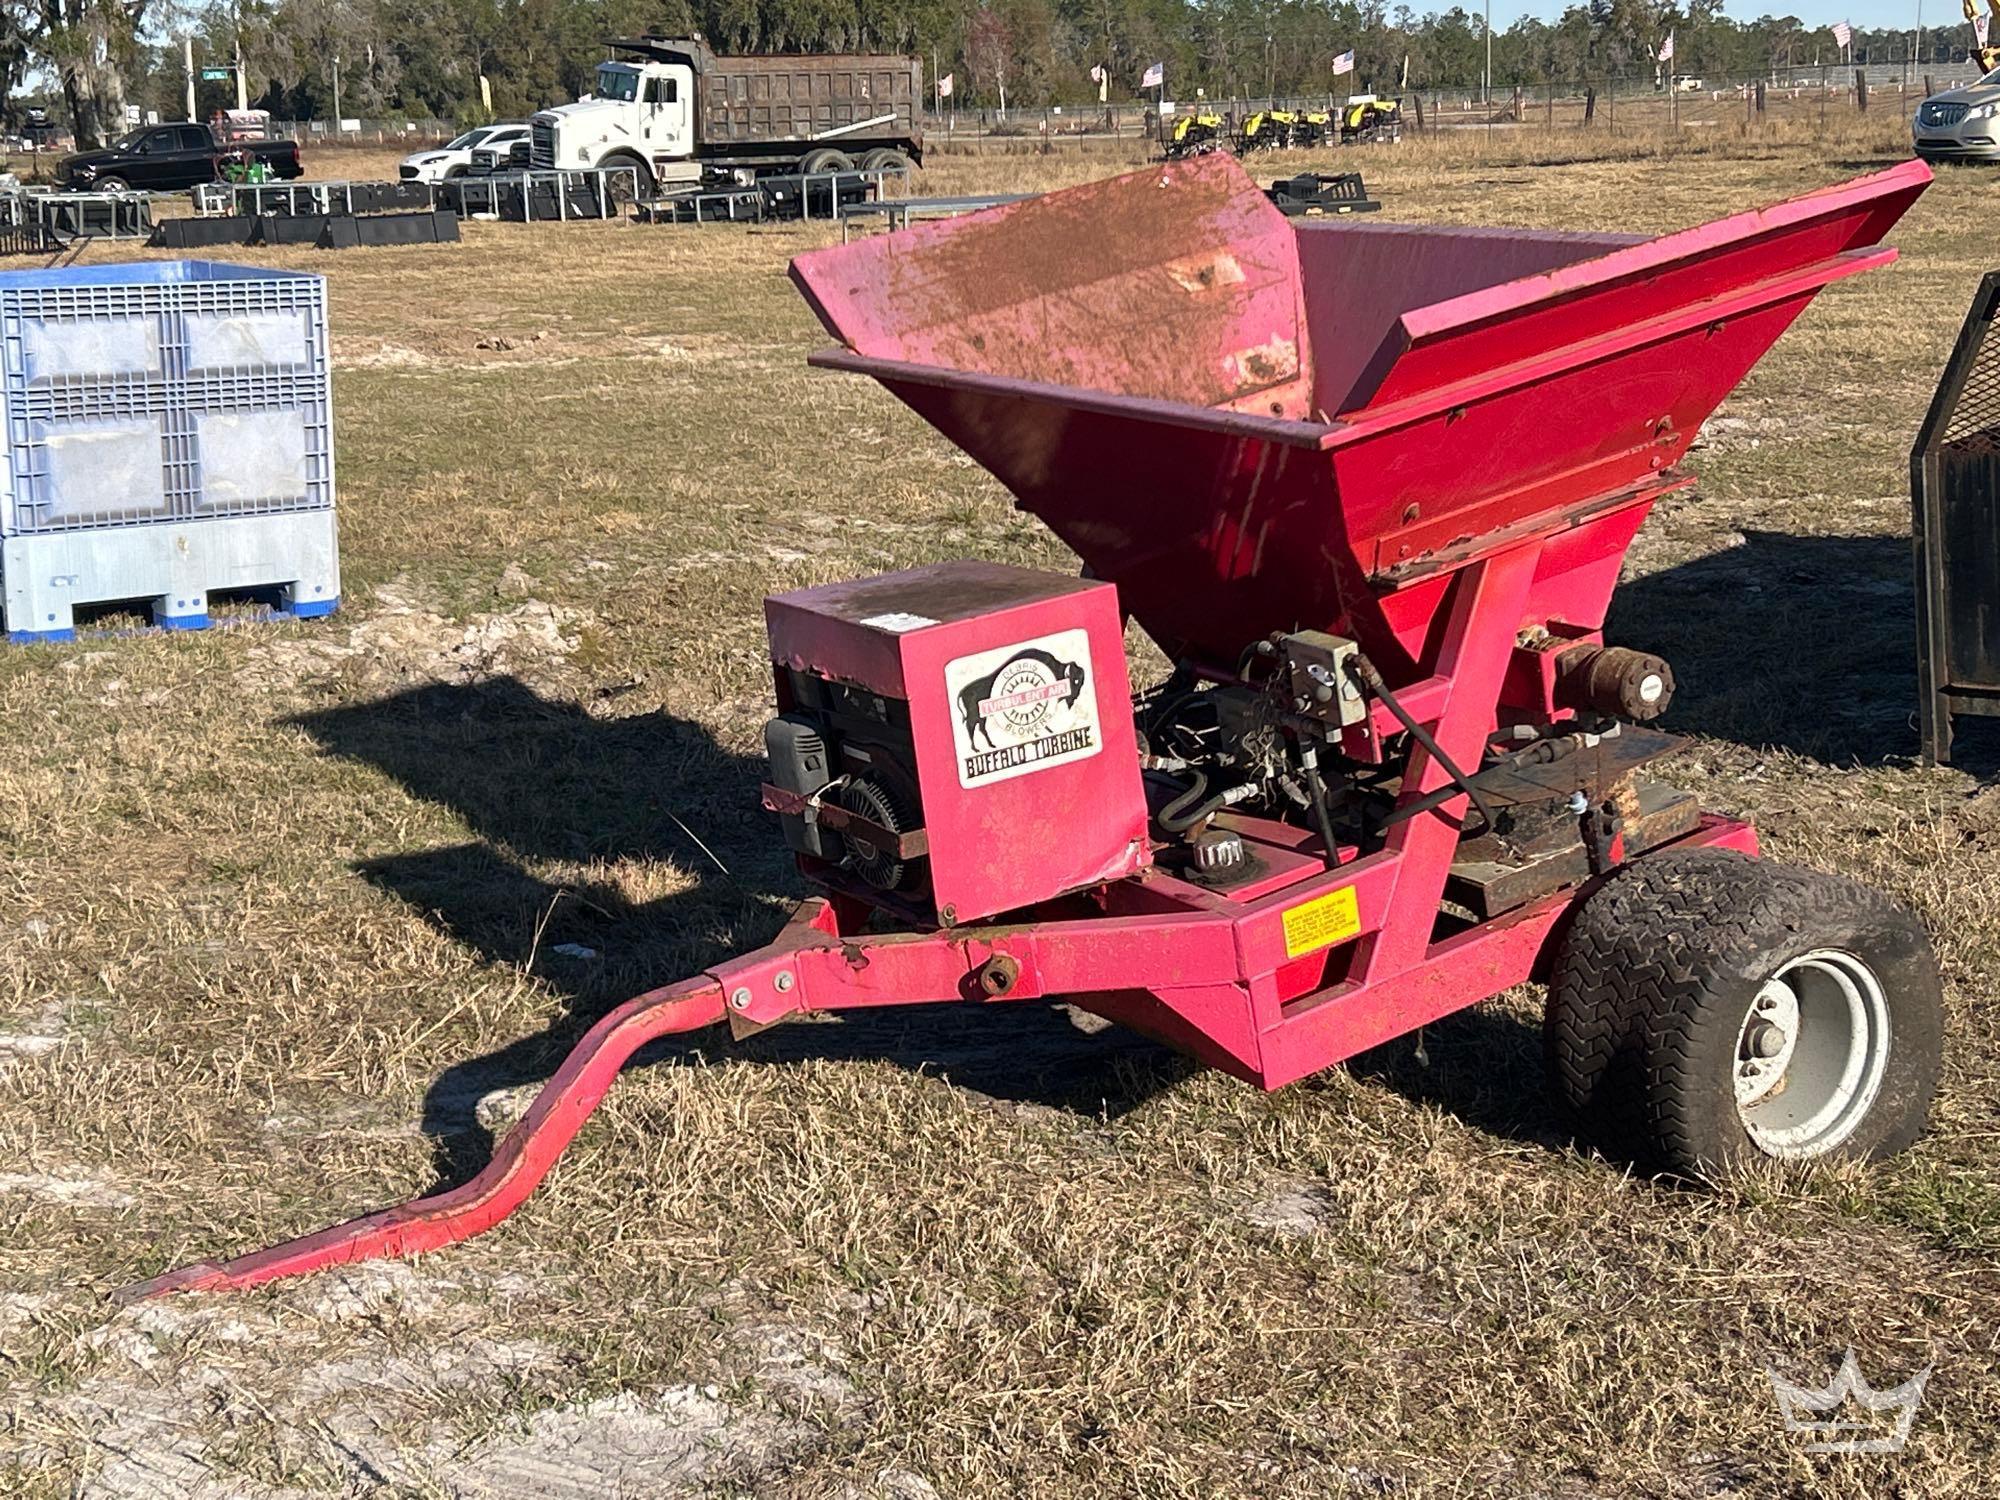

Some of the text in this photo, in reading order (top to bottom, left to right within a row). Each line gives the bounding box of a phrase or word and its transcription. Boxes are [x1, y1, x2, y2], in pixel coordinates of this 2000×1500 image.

[1003, 662, 1039, 679] DEBRIS
[982, 684, 1067, 715] TURBULENT AIR
[1005, 713, 1053, 736] BLOWERS
[965, 726, 1094, 779] BUFFALO TURBINE
